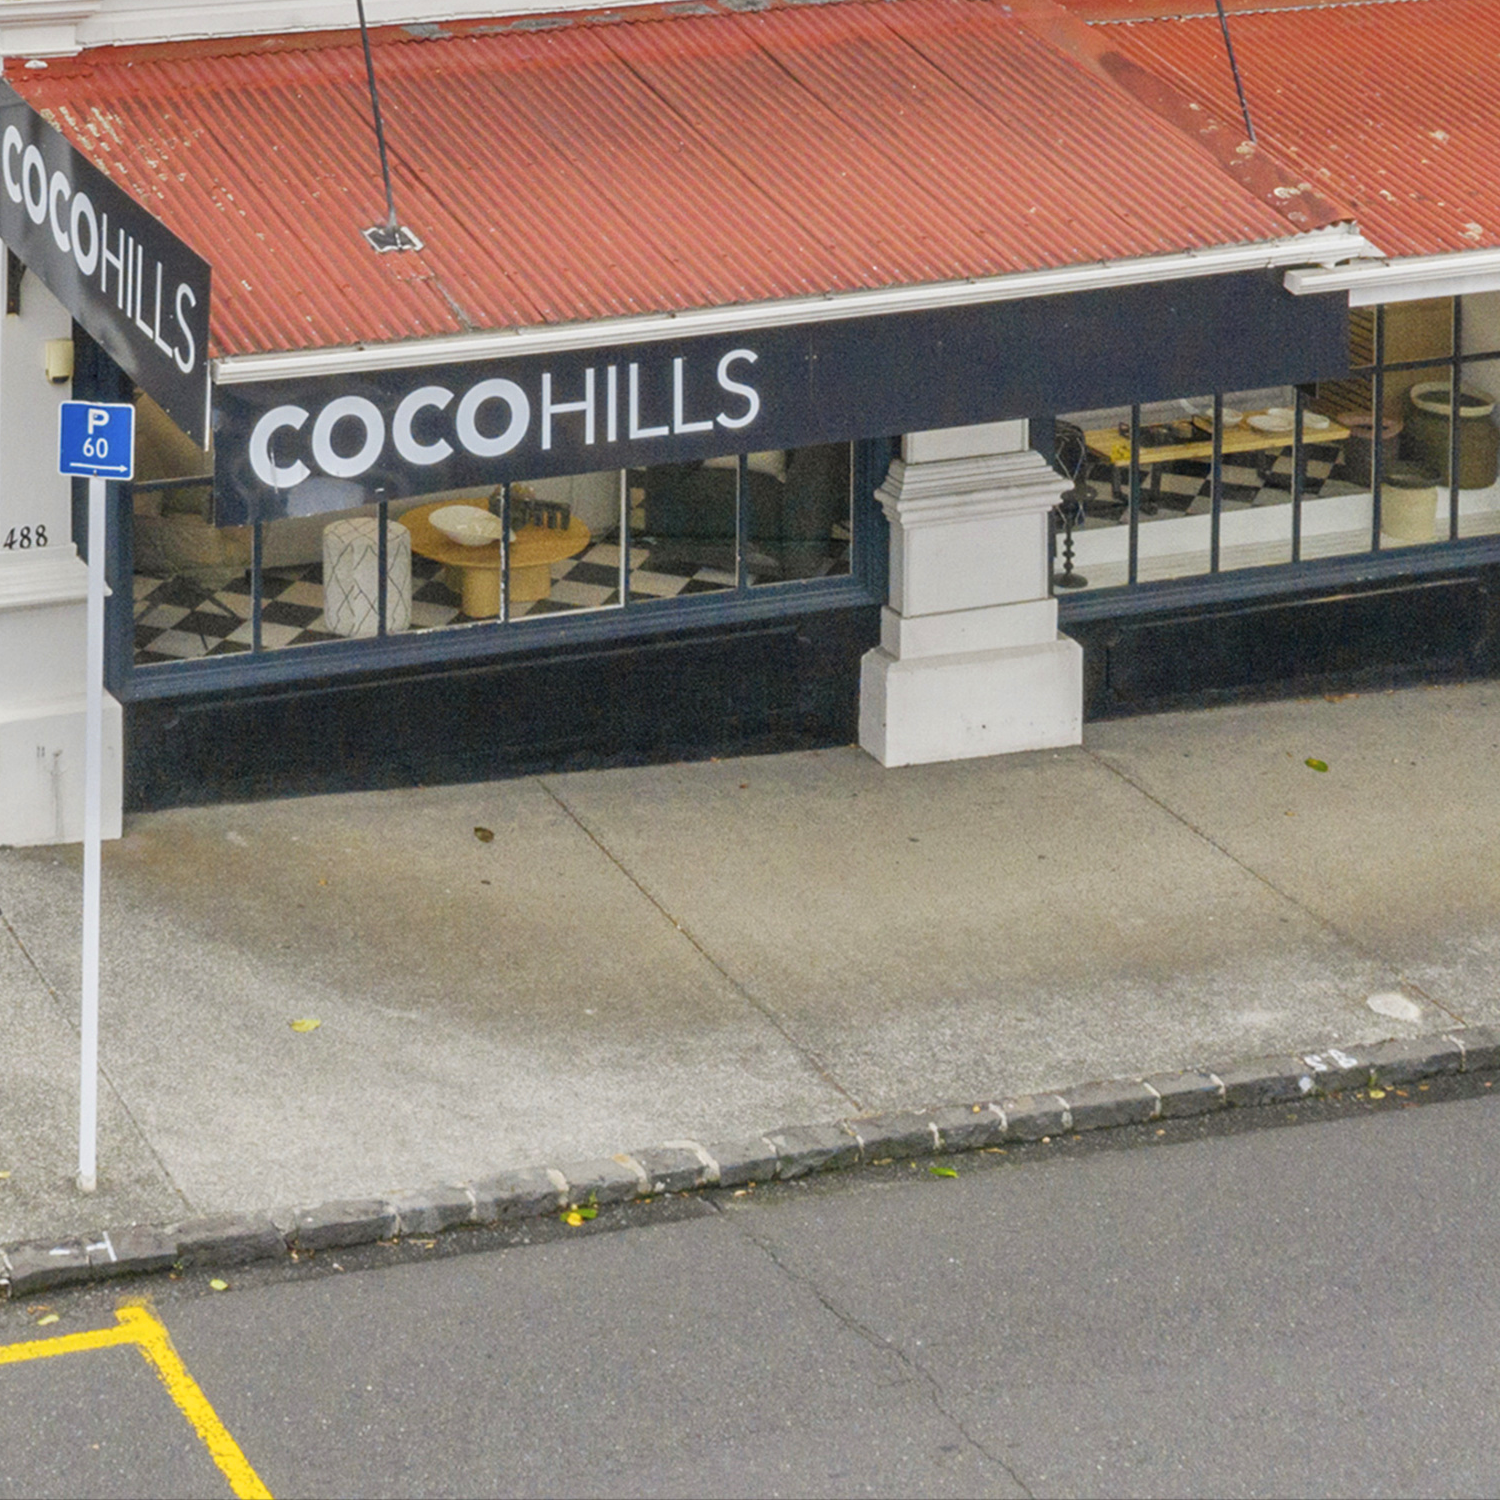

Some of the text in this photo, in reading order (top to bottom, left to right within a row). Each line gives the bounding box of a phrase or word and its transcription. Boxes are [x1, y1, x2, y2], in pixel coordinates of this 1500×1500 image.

[87, 408, 110, 435] P
[83, 437, 109, 459] 60
[3, 524, 48, 550] 488
